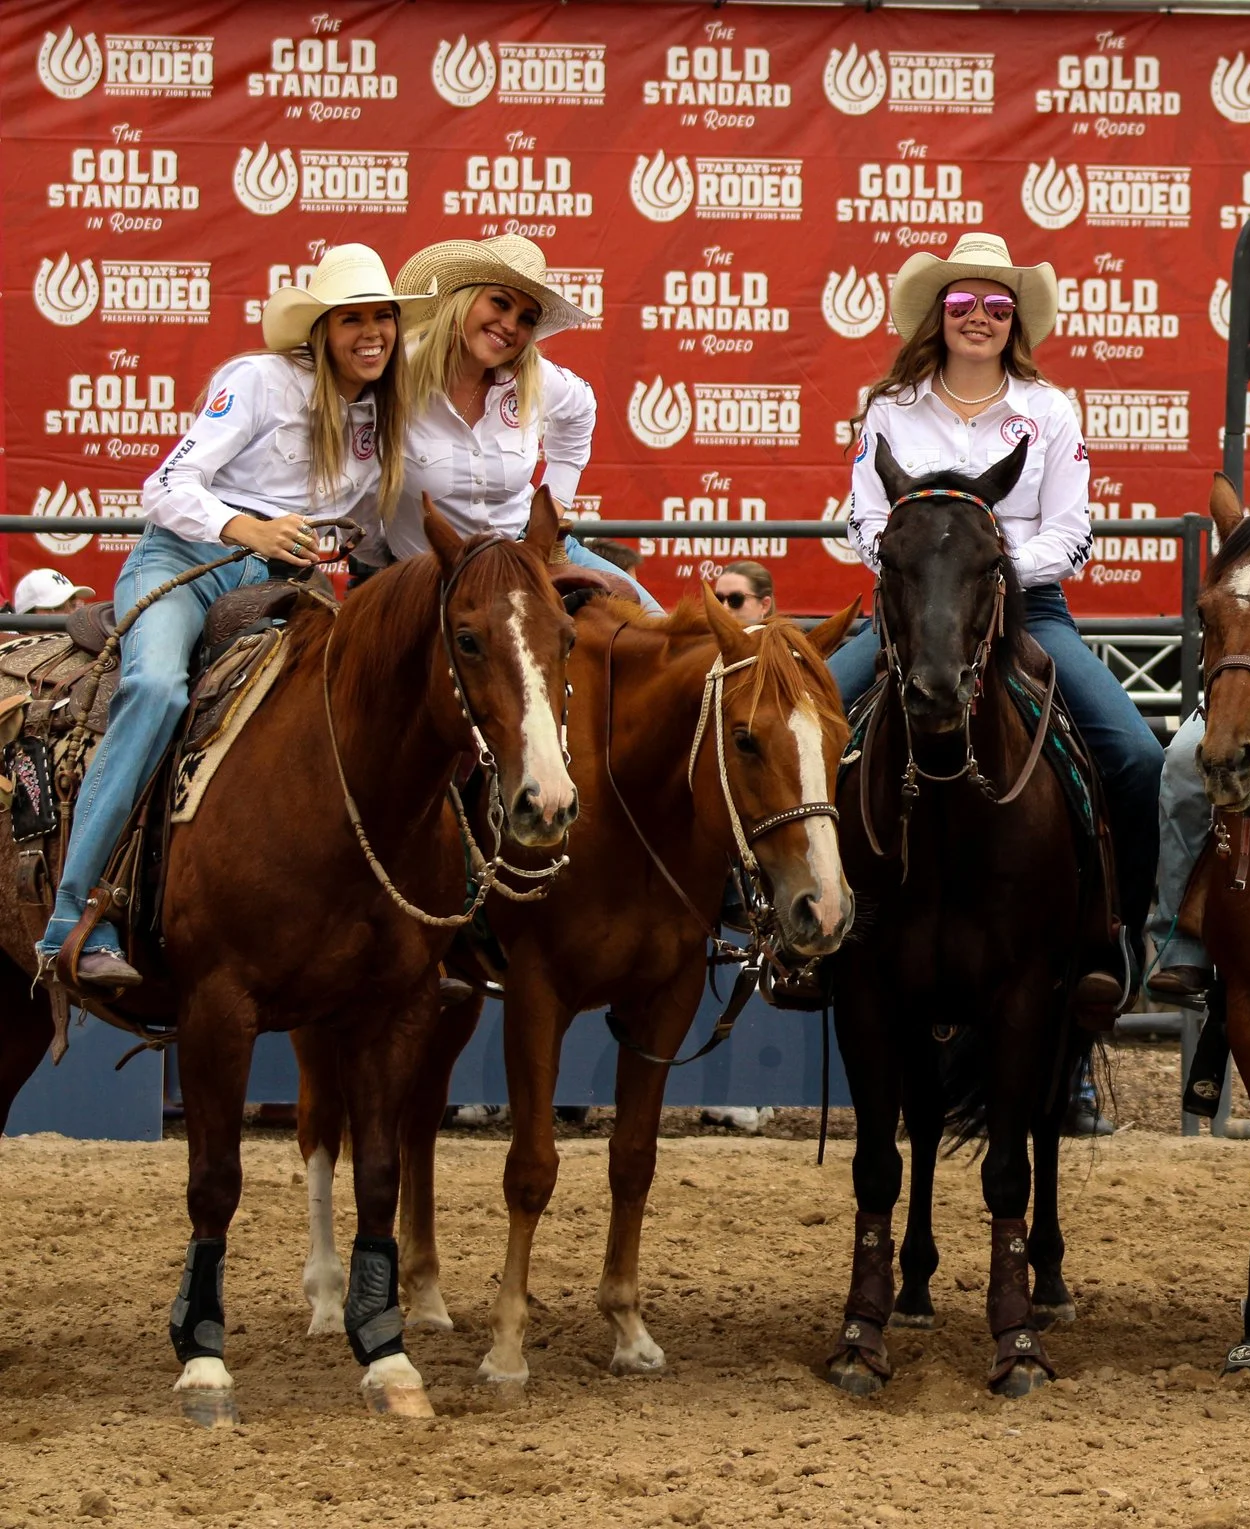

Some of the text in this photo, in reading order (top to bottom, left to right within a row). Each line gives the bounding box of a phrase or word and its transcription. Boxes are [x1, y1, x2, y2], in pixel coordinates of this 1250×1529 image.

[107, 40, 144, 50] UTAH
[146, 41, 180, 51] DAYS
[273, 38, 376, 73] GOLD
[500, 48, 536, 58] UTAH
[539, 49, 572, 58] DAYS
[108, 51, 213, 84] RODEO
[501, 59, 605, 91] RODEO
[668, 46, 770, 81] GOLD
[1059, 55, 1160, 90] GOLD
[106, 88, 150, 96] PRESENTED
[166, 89, 188, 97] ZIONS
[192, 90, 212, 98] BANK
[249, 74, 398, 99] STANDARD
[644, 81, 791, 108] STANDARD
[891, 68, 994, 100] RODEO
[287, 102, 361, 122] IN RODEO
[1036, 90, 1181, 116] STANDARD
[682, 109, 755, 130] IN RODEO
[1074, 118, 1145, 138] IN RODEO
[73, 148, 177, 184] GOLD
[302, 155, 339, 165] UTAH
[341, 156, 375, 166] DAYS
[303, 166, 408, 199] RODEO
[468, 156, 571, 191] GOLD
[861, 164, 962, 198] GOLD
[49, 184, 200, 210] STANDARD
[699, 174, 802, 207] RODEO
[1089, 182, 1190, 214] RODEO
[361, 204, 383, 212] ZIONS
[387, 205, 407, 213] BANK
[444, 190, 593, 217] STANDARD
[838, 199, 983, 224] STANDARD
[88, 212, 162, 233] IN RODEO
[483, 218, 556, 239] IN RODEO
[875, 226, 947, 246] IN RODEO
[103, 266, 140, 276] UTAH
[143, 267, 177, 276] DAYS
[104, 277, 210, 310] RODEO
[666, 271, 768, 306] GOLD
[1057, 278, 1158, 312] GOLD
[103, 314, 147, 322] PRESENTED
[163, 315, 185, 323] ZIONS
[189, 316, 209, 324] BANK
[642, 306, 790, 332] STANDARD
[1055, 314, 1178, 338] TANDARD
[680, 334, 753, 355] IN RODEO
[1072, 341, 1144, 361] IN RODEO
[71, 375, 174, 409] GOLD
[696, 389, 732, 399] UTAH
[734, 390, 768, 399] DAYS
[46, 410, 196, 435] STANDARD
[697, 400, 800, 432] RODEO
[1087, 405, 1189, 437] RODEO
[85, 438, 159, 458] IN RODEO
[100, 494, 138, 505] UTAH
[640, 537, 788, 557] STANDARD
[1092, 537, 1176, 561] NDARD
[677, 565, 693, 577] IN
[1092, 565, 1141, 585] RODEO
